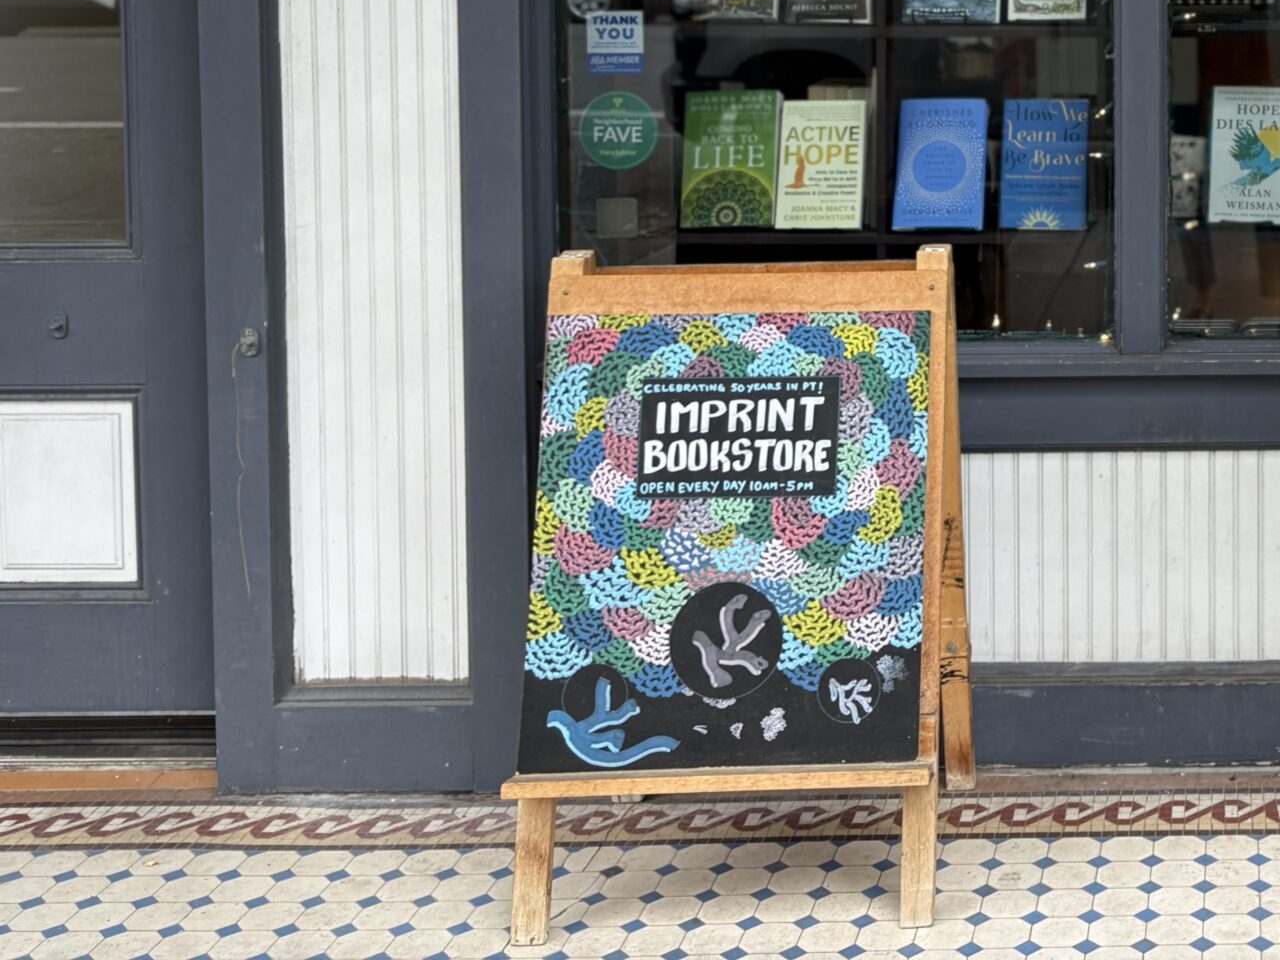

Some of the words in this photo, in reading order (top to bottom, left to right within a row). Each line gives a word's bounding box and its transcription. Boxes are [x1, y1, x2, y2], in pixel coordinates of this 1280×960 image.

[792, 4, 826, 12] REBECCA
[828, 3, 858, 11] SOLNIT
[592, 15, 639, 25] THANK
[595, 27, 635, 40] YOU
[606, 55, 640, 64] MEMBER
[690, 95, 736, 104] JOANNA
[741, 94, 772, 103] MACY
[911, 108, 974, 117] CHERISHED
[1006, 100, 1055, 122] How
[1050, 99, 1088, 123] We
[1237, 104, 1280, 116] HOPE
[1216, 118, 1253, 130] DIES
[593, 126, 643, 143] FAVE
[701, 134, 735, 145] BACK
[739, 134, 759, 144] TO
[785, 126, 860, 143] ACTIVE
[1006, 120, 1057, 150] Learn
[693, 144, 765, 169] LIFE
[784, 144, 859, 166] HOPE
[1005, 149, 1027, 168] Be
[1030, 149, 1085, 172] Brave
[1238, 186, 1272, 198] ALAN
[643, 383, 725, 394] CELEBRATING
[730, 382, 745, 392] 50
[745, 382, 782, 393] YEARS
[786, 382, 798, 391] IN
[802, 381, 824, 394] PT!
[655, 396, 826, 434] IMPRINT
[643, 438, 832, 474] BOOKSTORE
[640, 482, 675, 494] OPEN
[678, 480, 720, 494] EVERY
[724, 480, 747, 494] DAY
